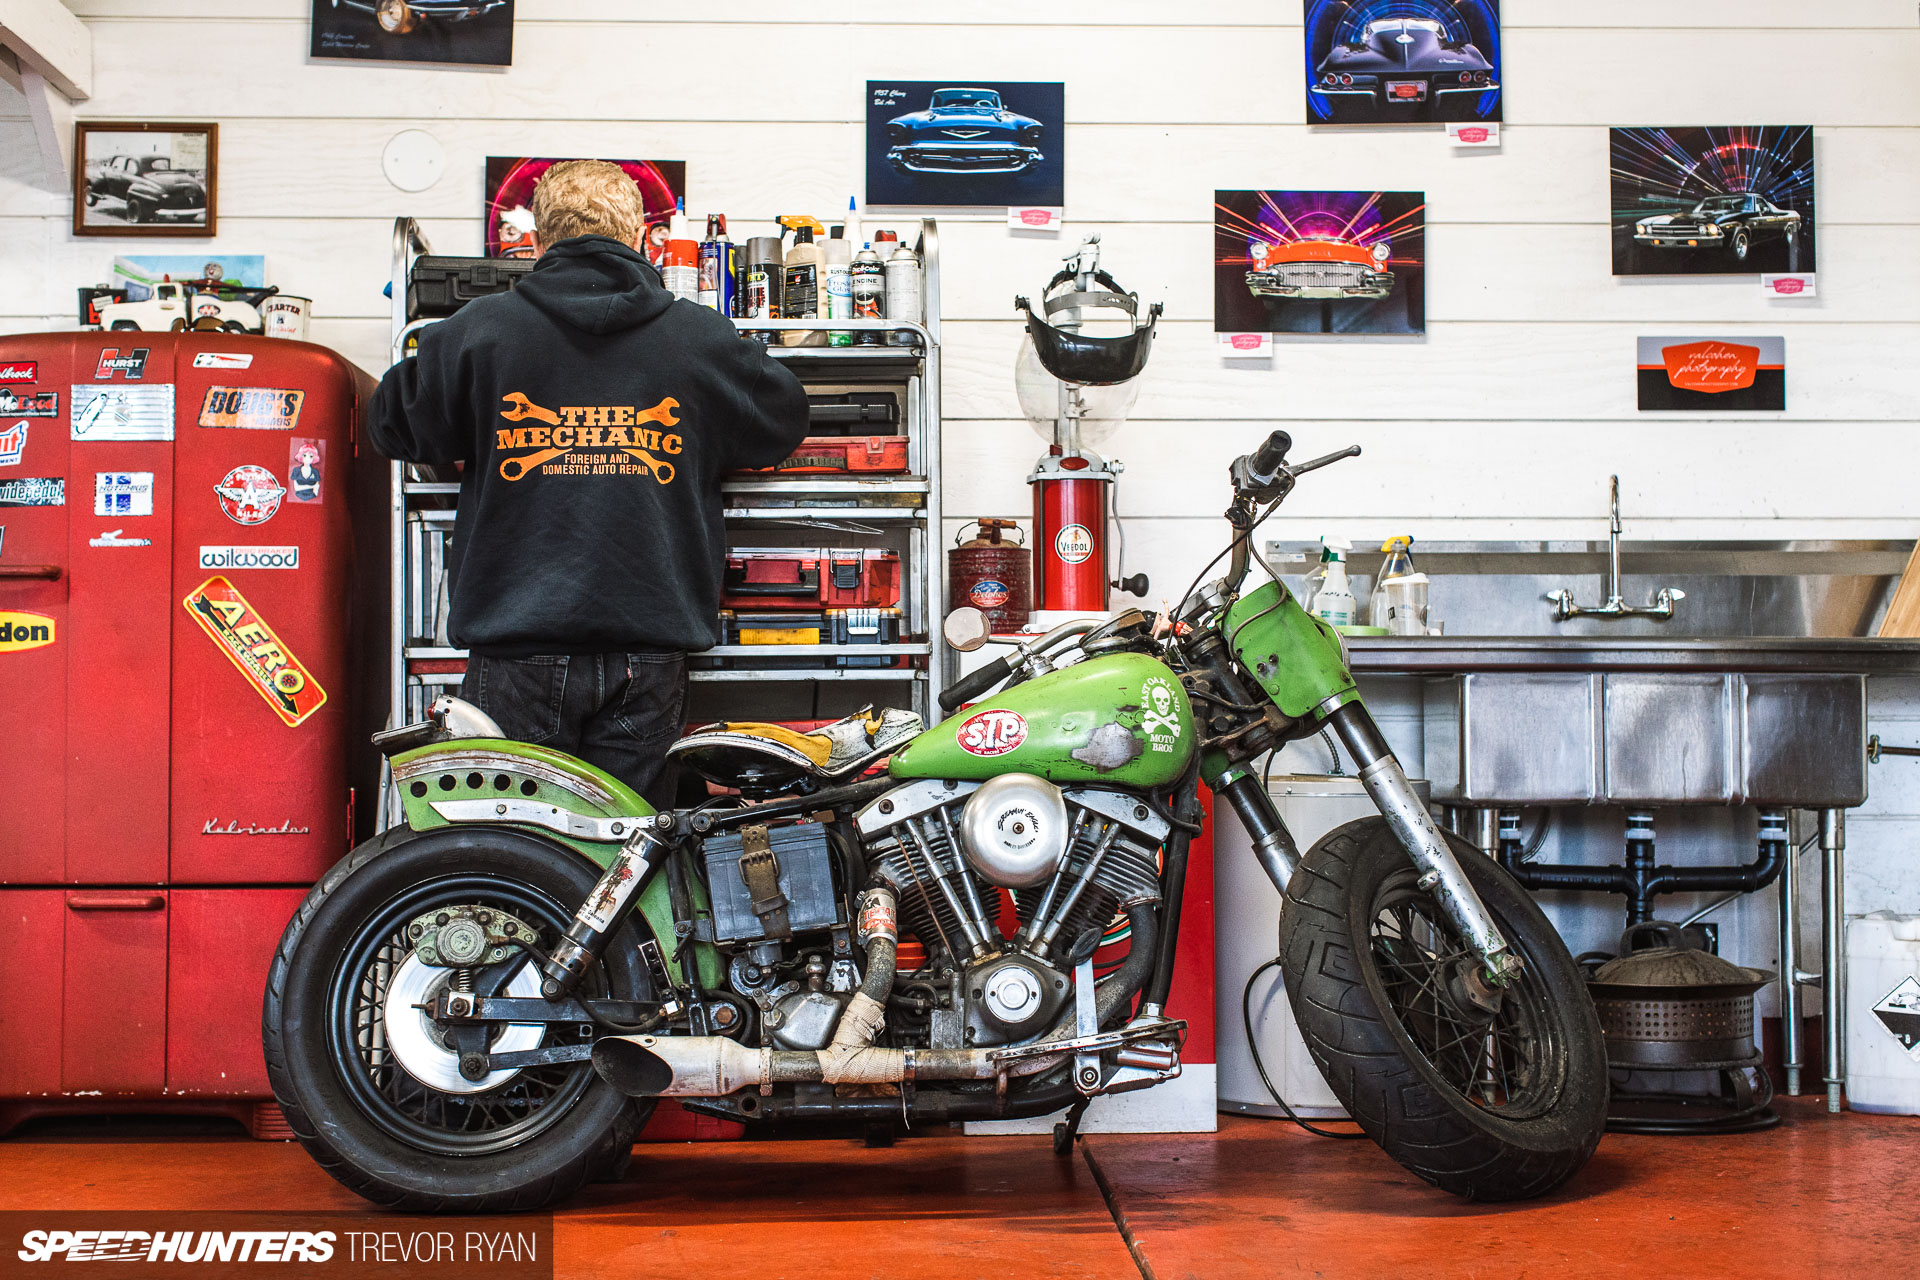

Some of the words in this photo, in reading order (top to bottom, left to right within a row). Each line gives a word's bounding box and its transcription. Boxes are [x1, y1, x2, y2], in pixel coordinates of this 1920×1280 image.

[102, 359, 142, 369] HURST
[1673, 359, 1747, 382] photography
[0, 366, 33, 379] lbrock
[207, 391, 299, 417] DOUG'S
[560, 406, 635, 427] THE
[496, 426, 683, 455] MECHANIC
[564, 453, 607, 464] FOREIGN
[609, 453, 629, 464] AND
[542, 464, 590, 475] DOMESTIC
[592, 464, 616, 475] AUTO
[619, 464, 649, 476] REPAIR
[1060, 541, 1088, 552] VEEDOL
[201, 547, 298, 567] wilwood
[208, 600, 305, 695] AERO
[1141, 682, 1151, 709] EAST
[1146, 676, 1181, 712] OAKLAND
[964, 711, 1021, 749] STP
[1149, 733, 1175, 744] MOTO
[1152, 743, 1174, 753] BROS
[864, 906, 896, 921] TECAT
[1905, 1033, 1911, 1045] 8
